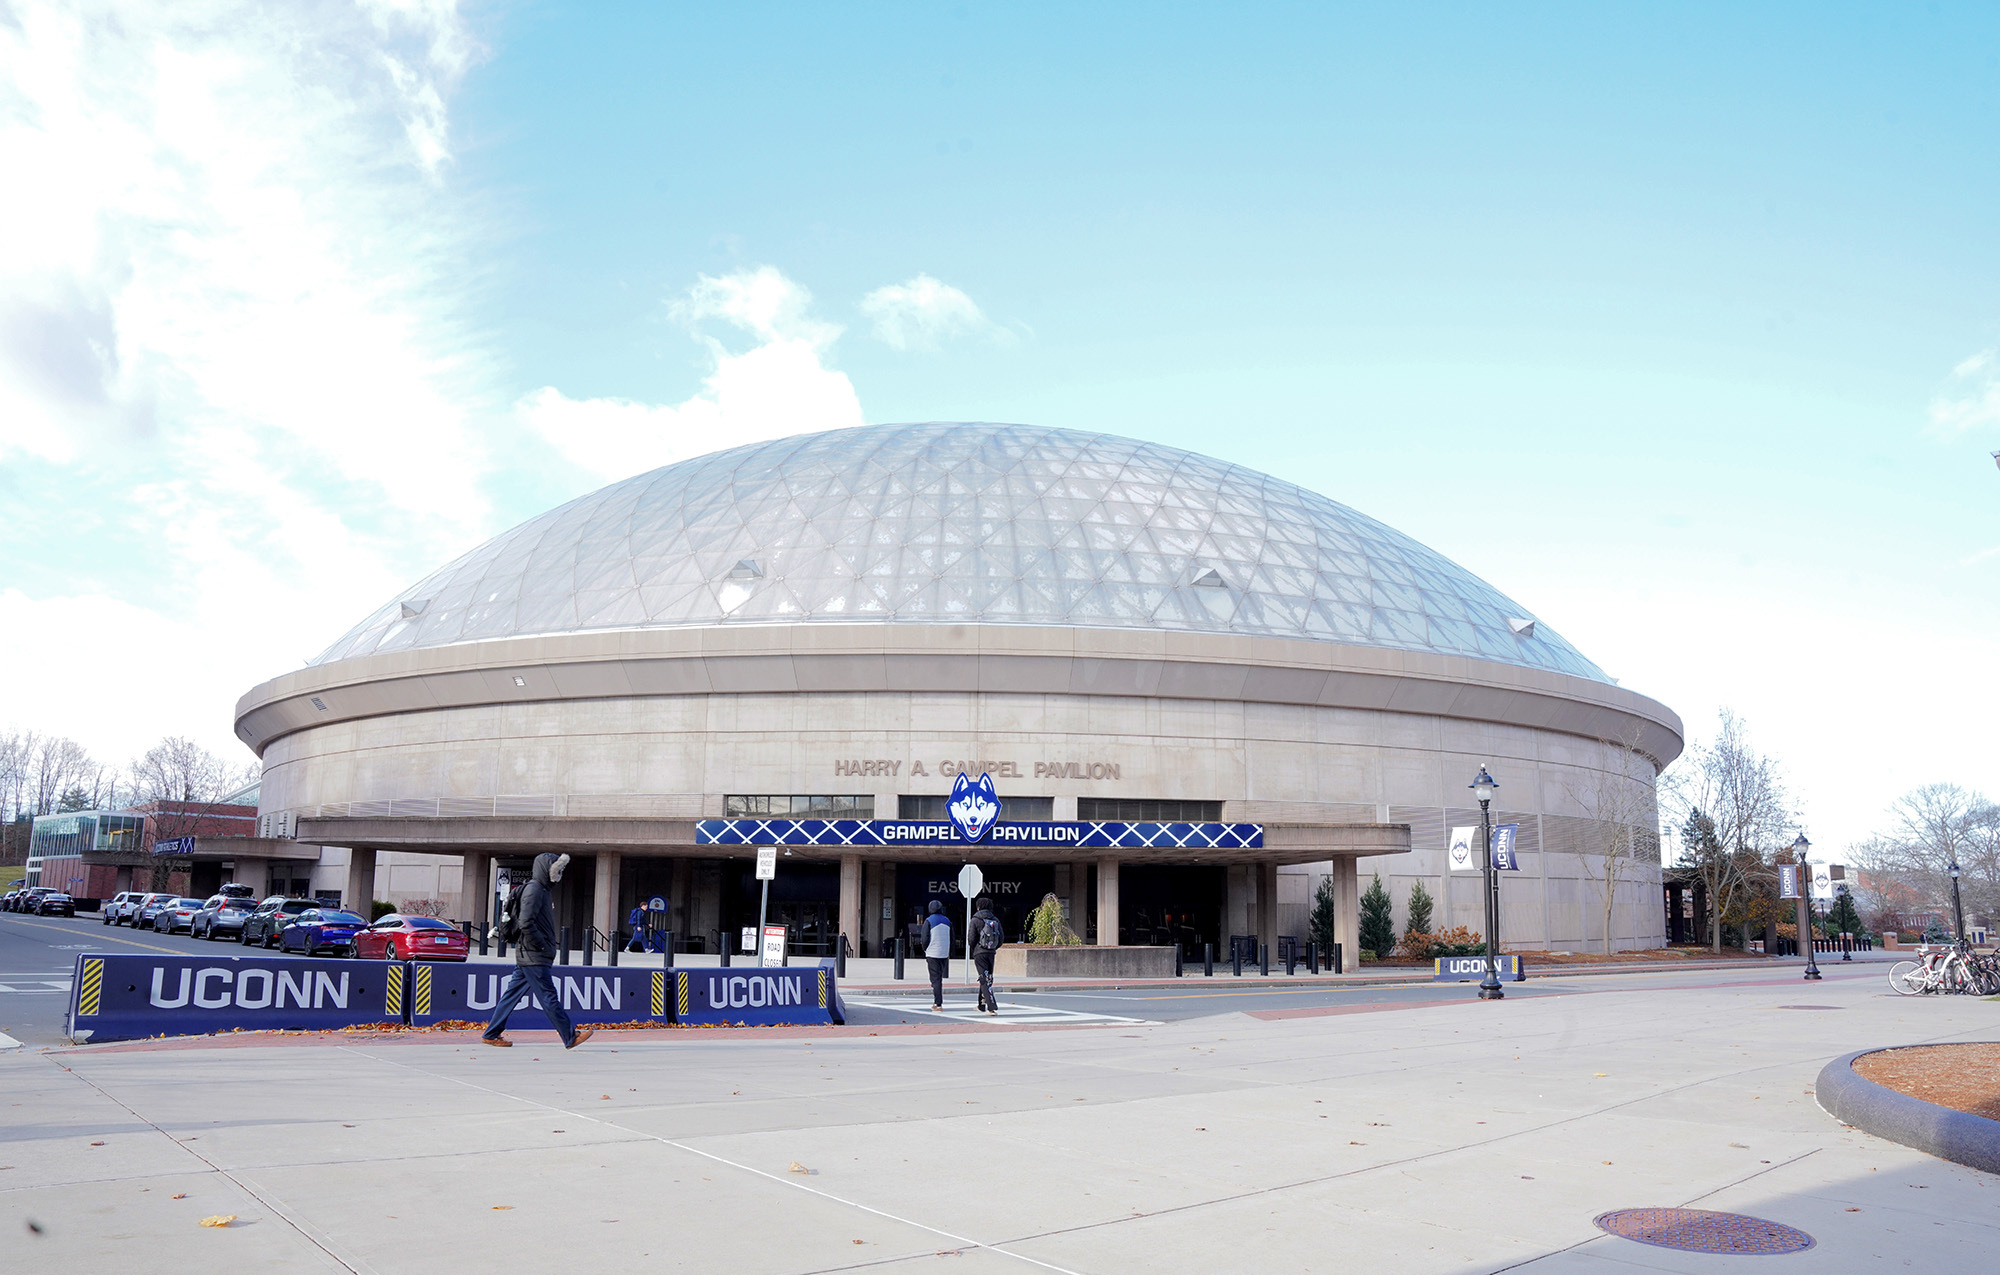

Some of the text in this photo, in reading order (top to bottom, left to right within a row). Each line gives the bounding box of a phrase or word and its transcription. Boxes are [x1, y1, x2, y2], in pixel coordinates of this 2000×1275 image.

[834, 759, 1121, 780] HARRY A. GAMPEL PAVILION
[883, 825, 1080, 841] GAMPEL PAVILION
[1497, 828, 1509, 869] UCONN
[928, 881, 1022, 893] EAS NTRY
[1783, 867, 1792, 896] UCONN
[150, 967, 350, 1009] UCONN
[709, 975, 801, 1009] UCONN
